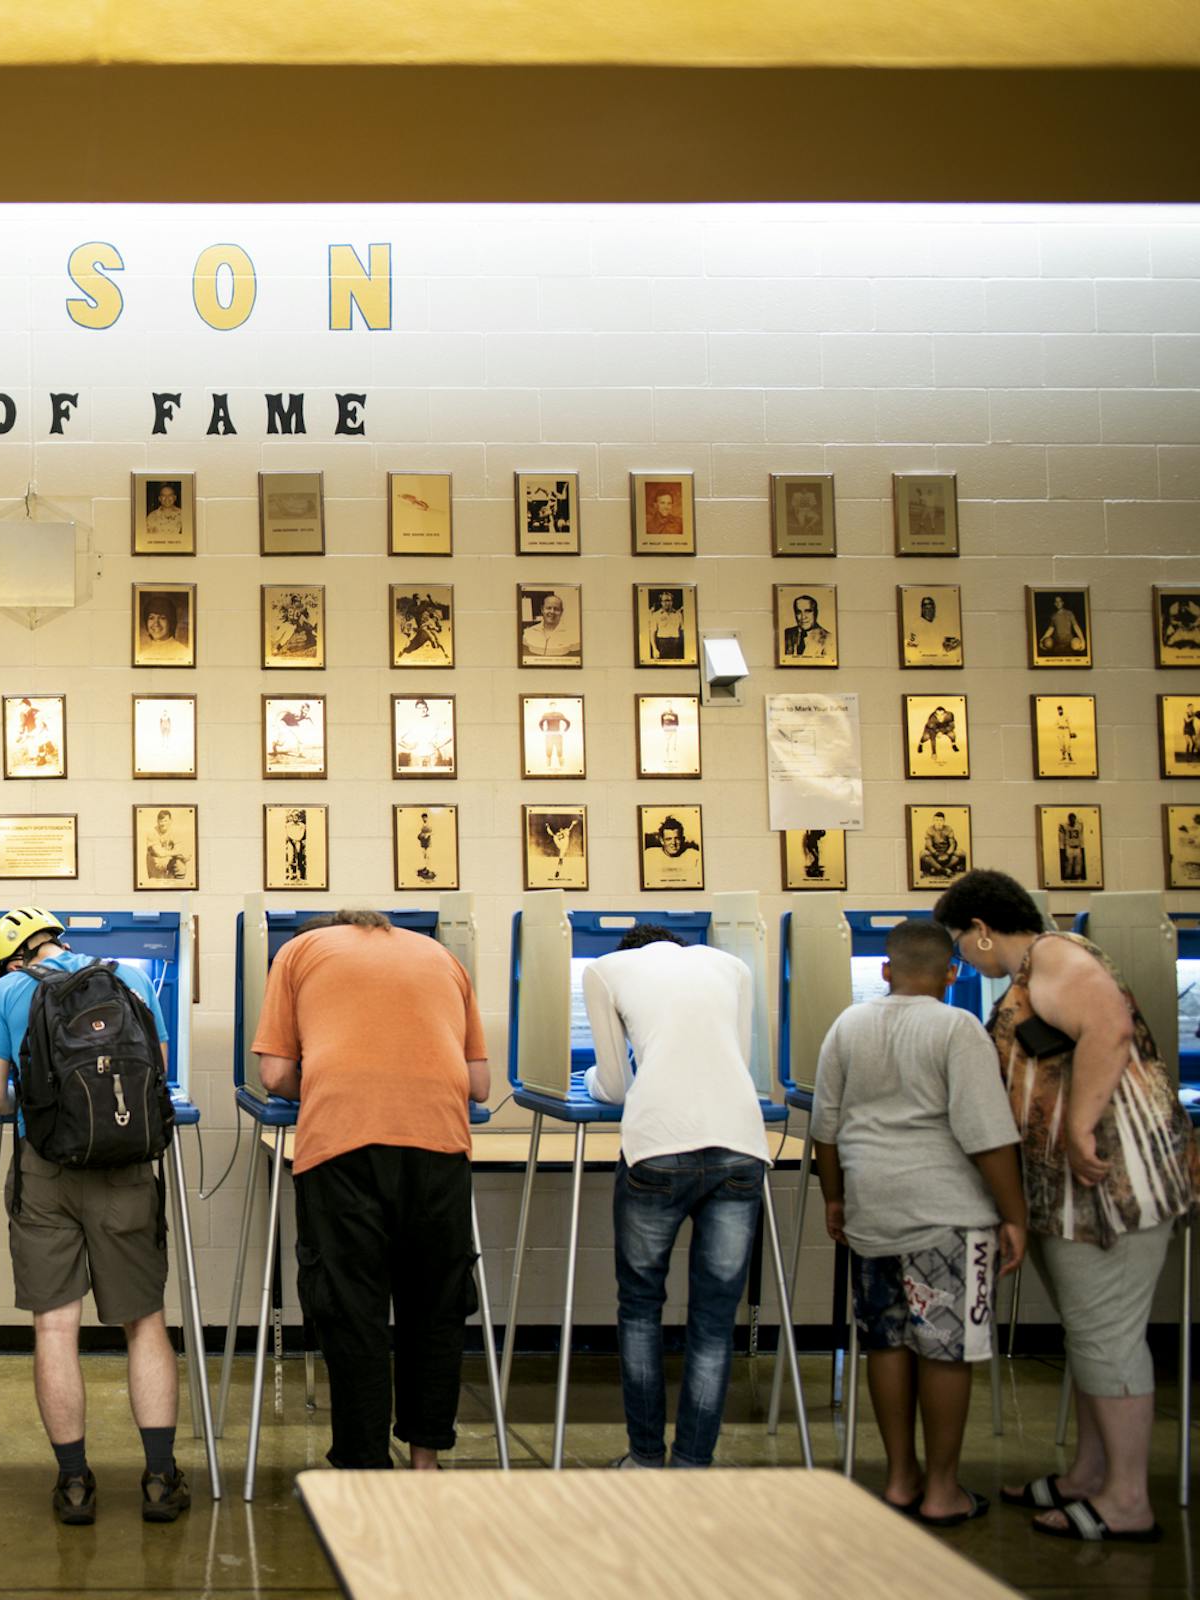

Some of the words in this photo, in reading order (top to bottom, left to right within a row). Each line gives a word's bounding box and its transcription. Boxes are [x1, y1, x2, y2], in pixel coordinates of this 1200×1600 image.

[151, 392, 367, 436] FAME
[794, 705, 812, 713] Mark
[813, 705, 828, 713] Your
